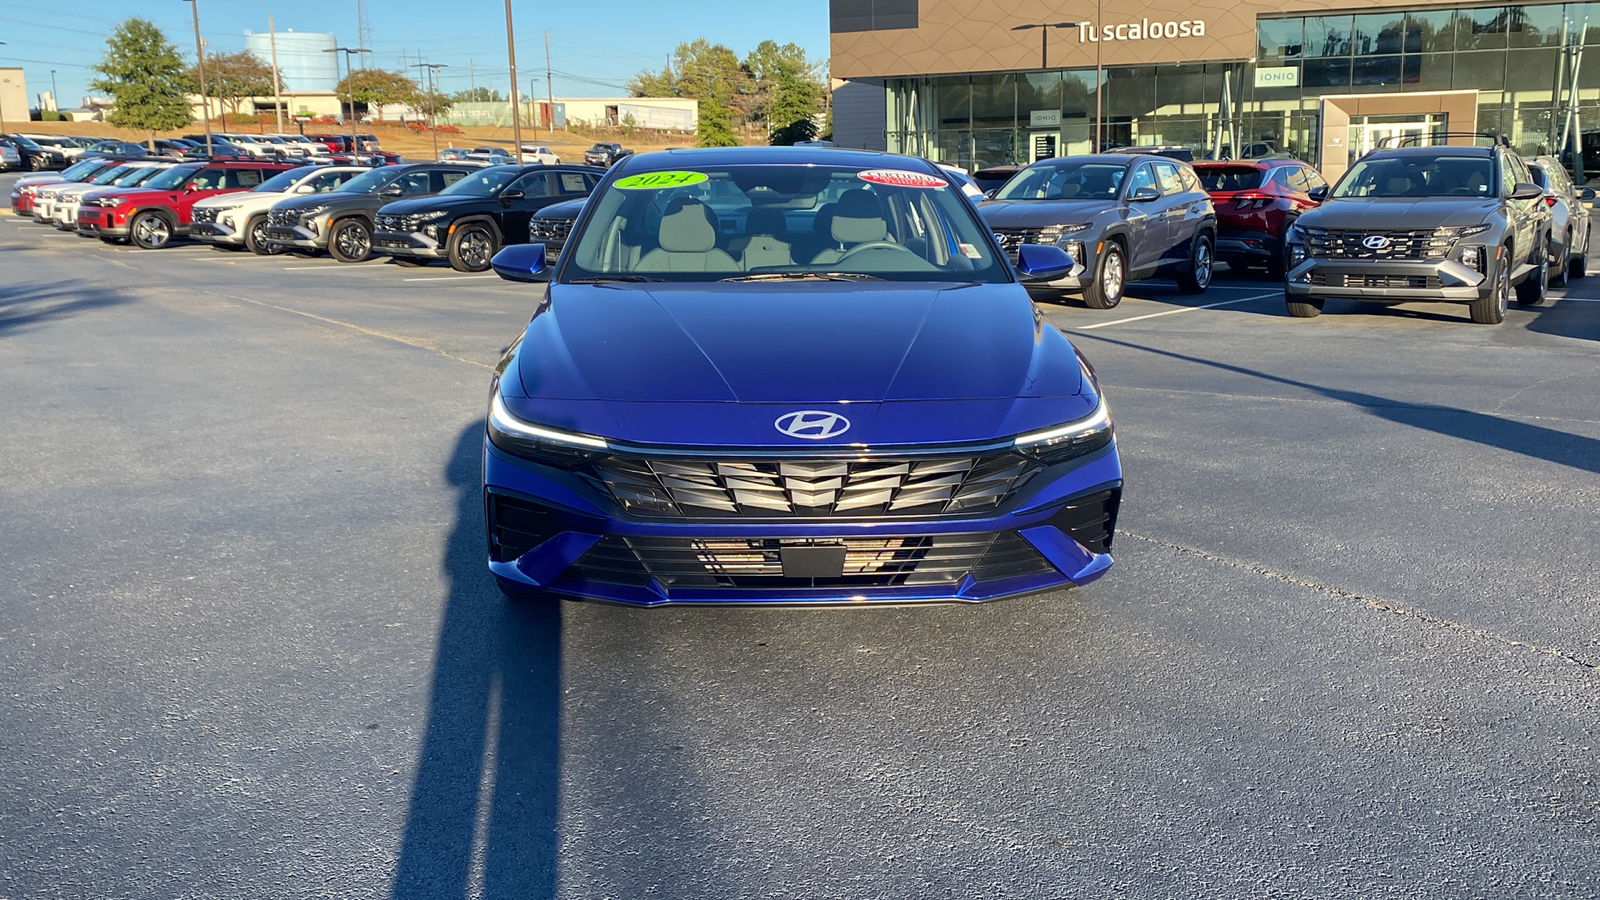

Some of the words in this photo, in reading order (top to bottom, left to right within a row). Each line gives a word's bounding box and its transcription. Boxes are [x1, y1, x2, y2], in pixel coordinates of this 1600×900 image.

[1079, 18, 1206, 43] Tuscaloosa
[1260, 72, 1294, 81] IONIQ
[625, 173, 695, 187] 2024
